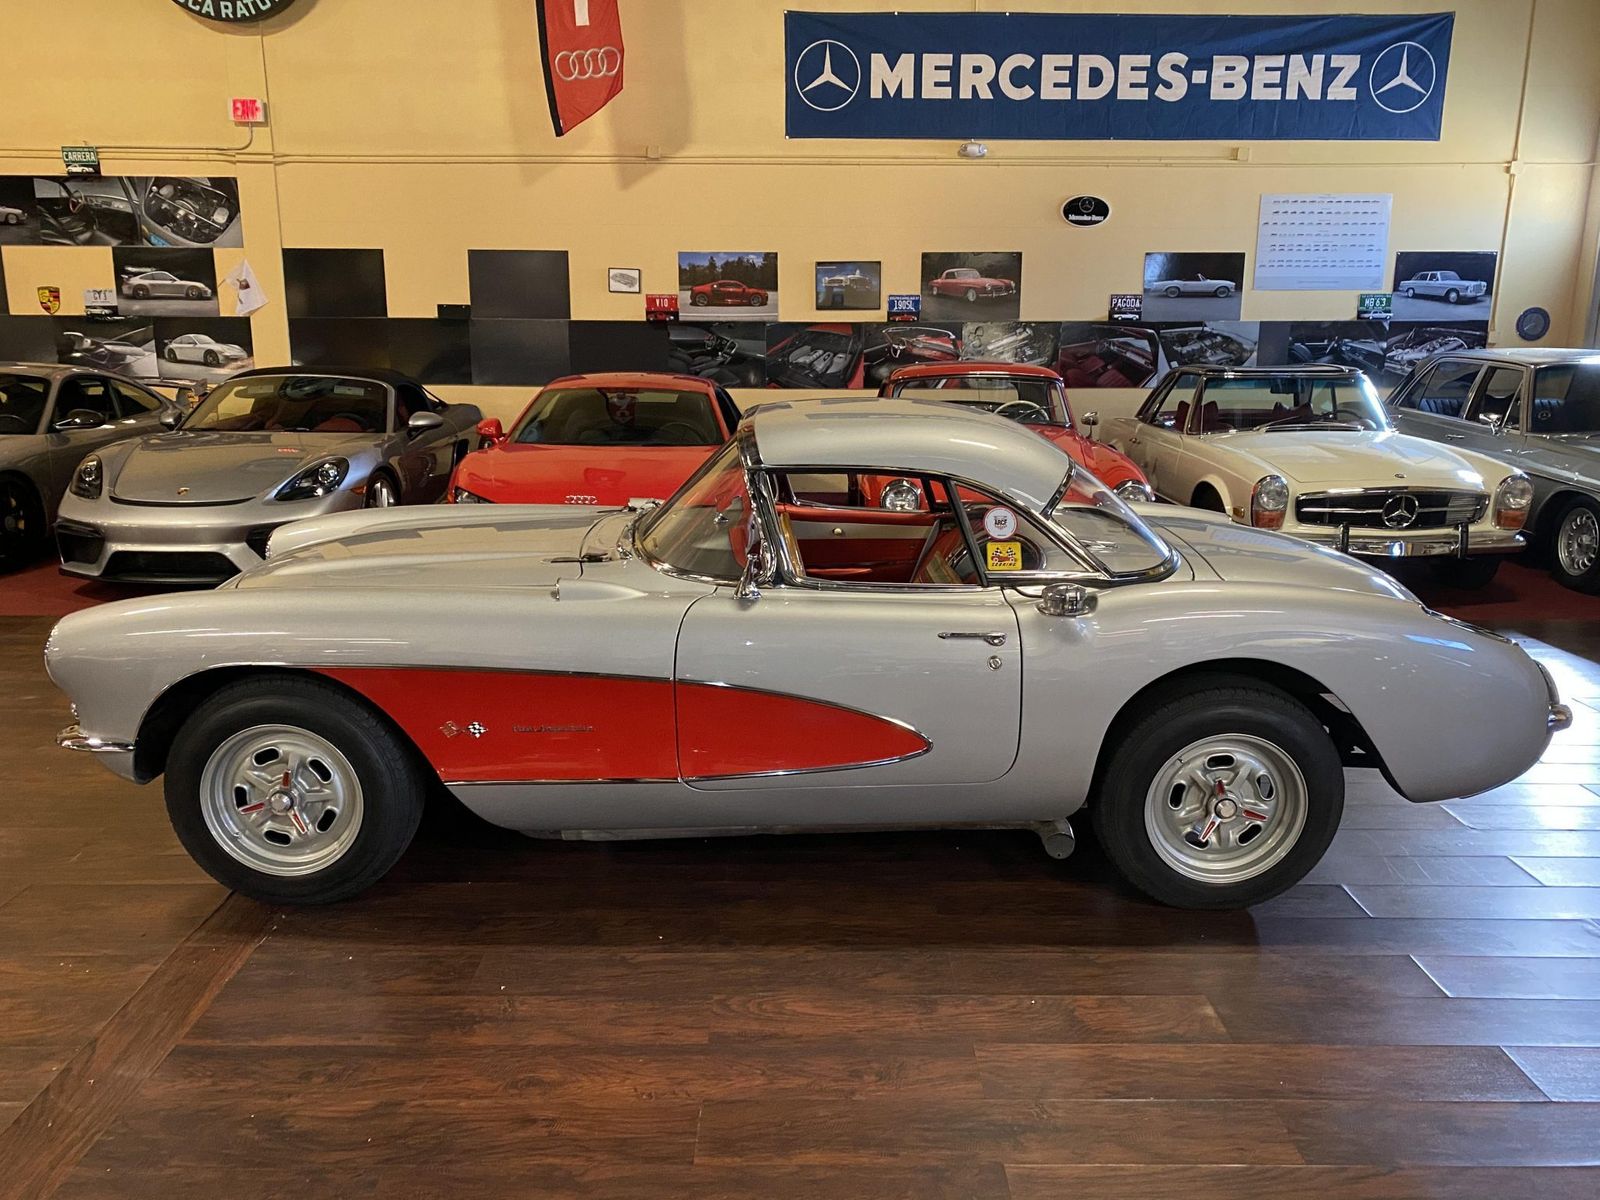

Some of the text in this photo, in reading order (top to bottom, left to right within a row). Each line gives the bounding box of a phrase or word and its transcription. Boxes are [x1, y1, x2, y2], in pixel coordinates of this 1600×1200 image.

[220, 0, 280, 18] RATO
[870, 52, 1361, 101] MERCEDES-BENZ
[63, 151, 96, 161] CARRERA
